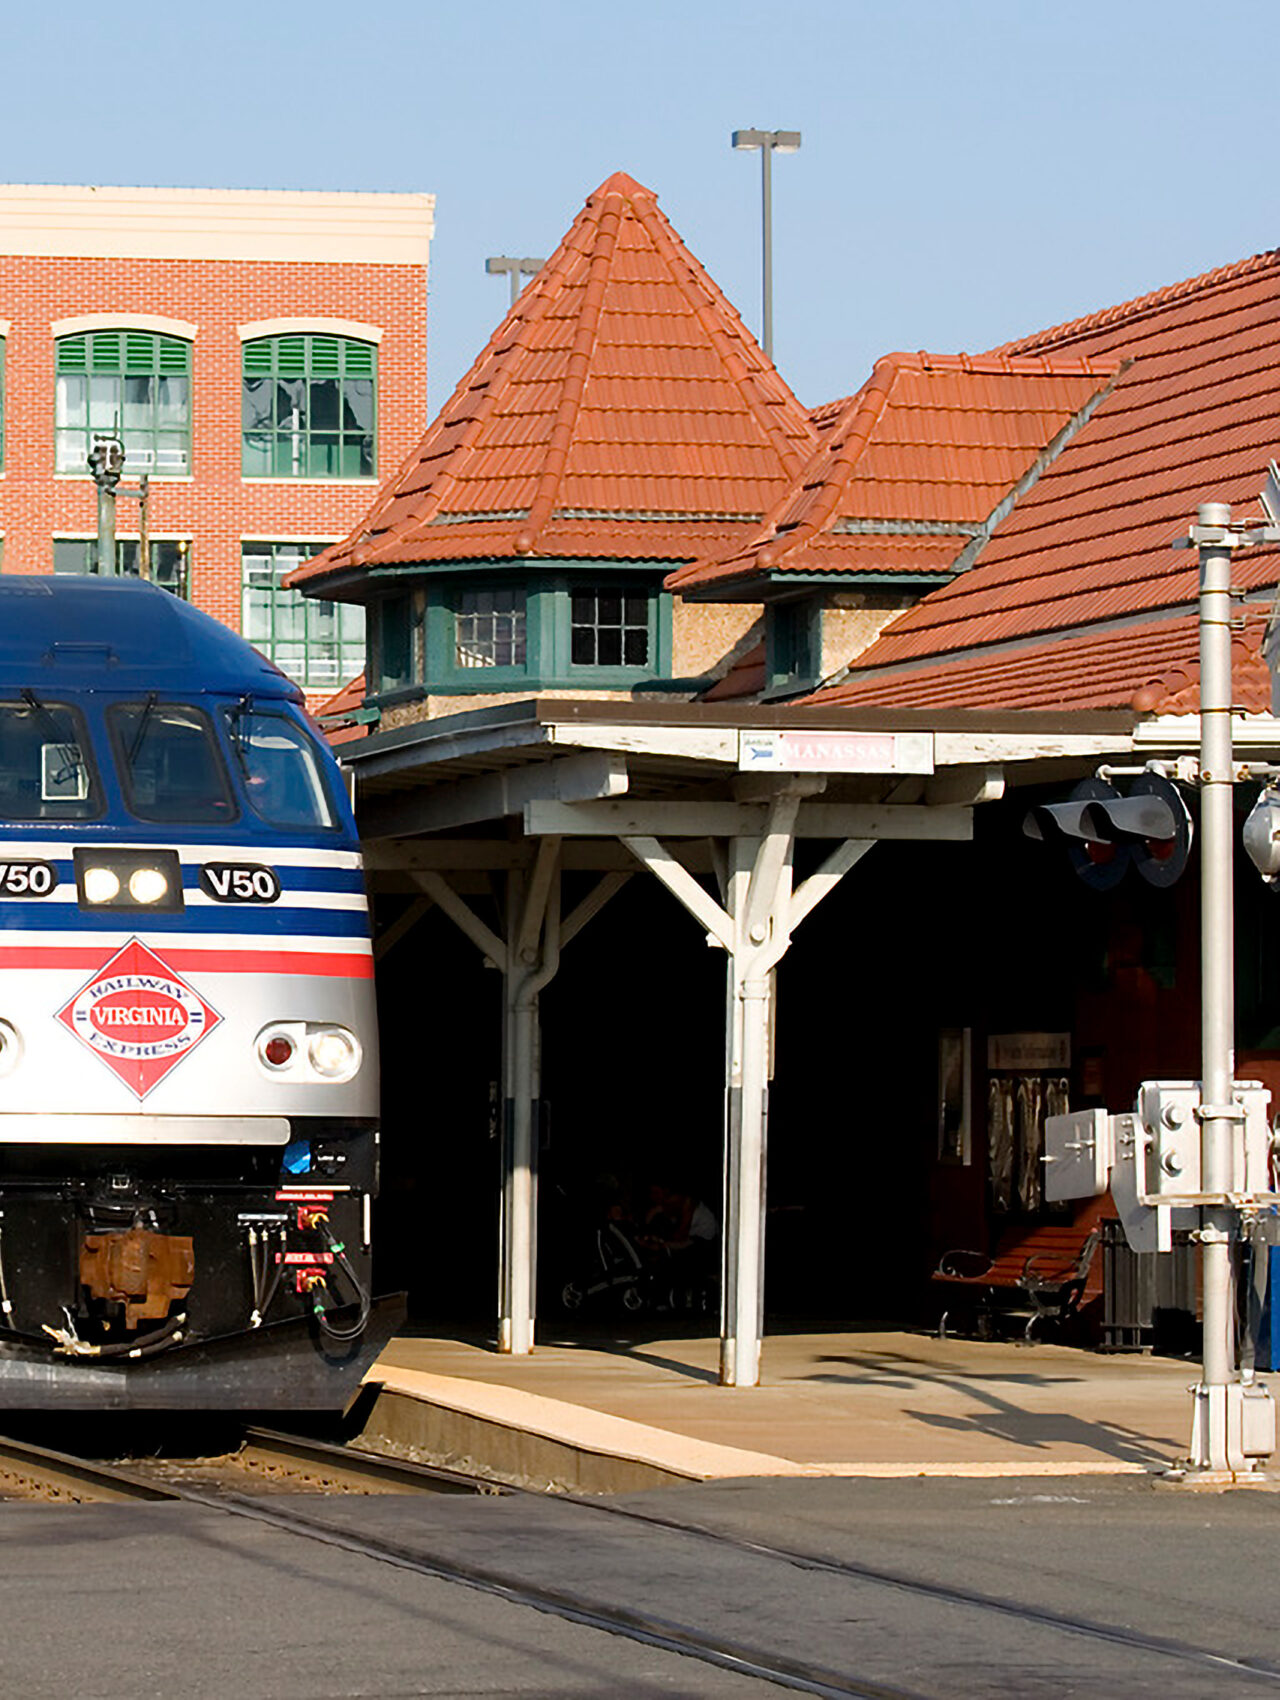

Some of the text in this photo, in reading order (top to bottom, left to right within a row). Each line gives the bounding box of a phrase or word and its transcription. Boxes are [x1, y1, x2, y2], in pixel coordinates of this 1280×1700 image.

[204, 869, 276, 898] V50
[89, 977, 190, 999] RAILWAY
[91, 1006, 187, 1026] VIRGINIA
[89, 1032, 191, 1056] EXPRESS
